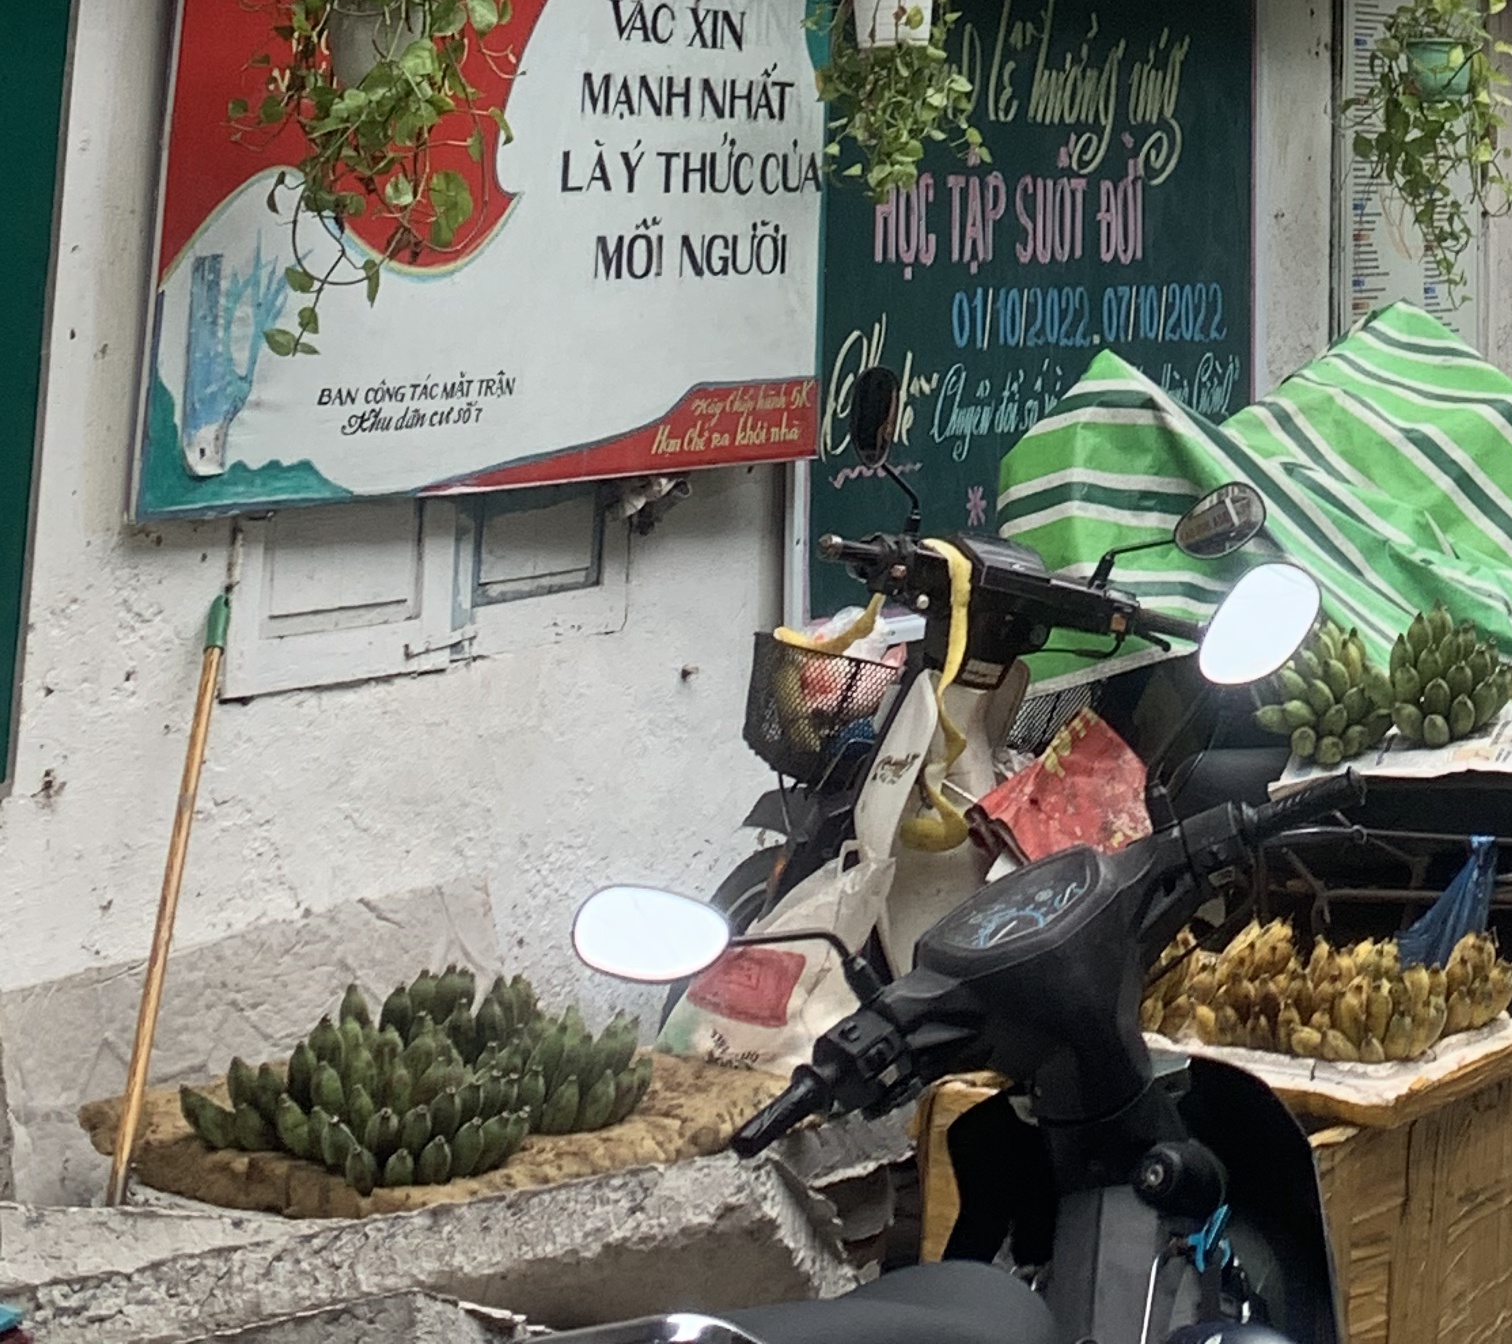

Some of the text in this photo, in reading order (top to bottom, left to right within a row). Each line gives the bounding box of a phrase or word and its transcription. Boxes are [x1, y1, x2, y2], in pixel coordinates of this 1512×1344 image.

[581, 62, 796, 122] MẠNH NHẤT
[618, 138, 646, 194] Ý
[656, 131, 754, 196] THỨC
[760, 138, 822, 195] CỦA
[874, 130, 1146, 280] HỌC TẬP SUỐT ĐỜI
[594, 216, 788, 280] MỖI NGƯỜI
[317, 387, 359, 406] BAN
[364, 378, 406, 405] CÔNG
[409, 373, 440, 401] TÁC
[476, 370, 516, 399] TRẬN
[341, 407, 391, 435] Khu
